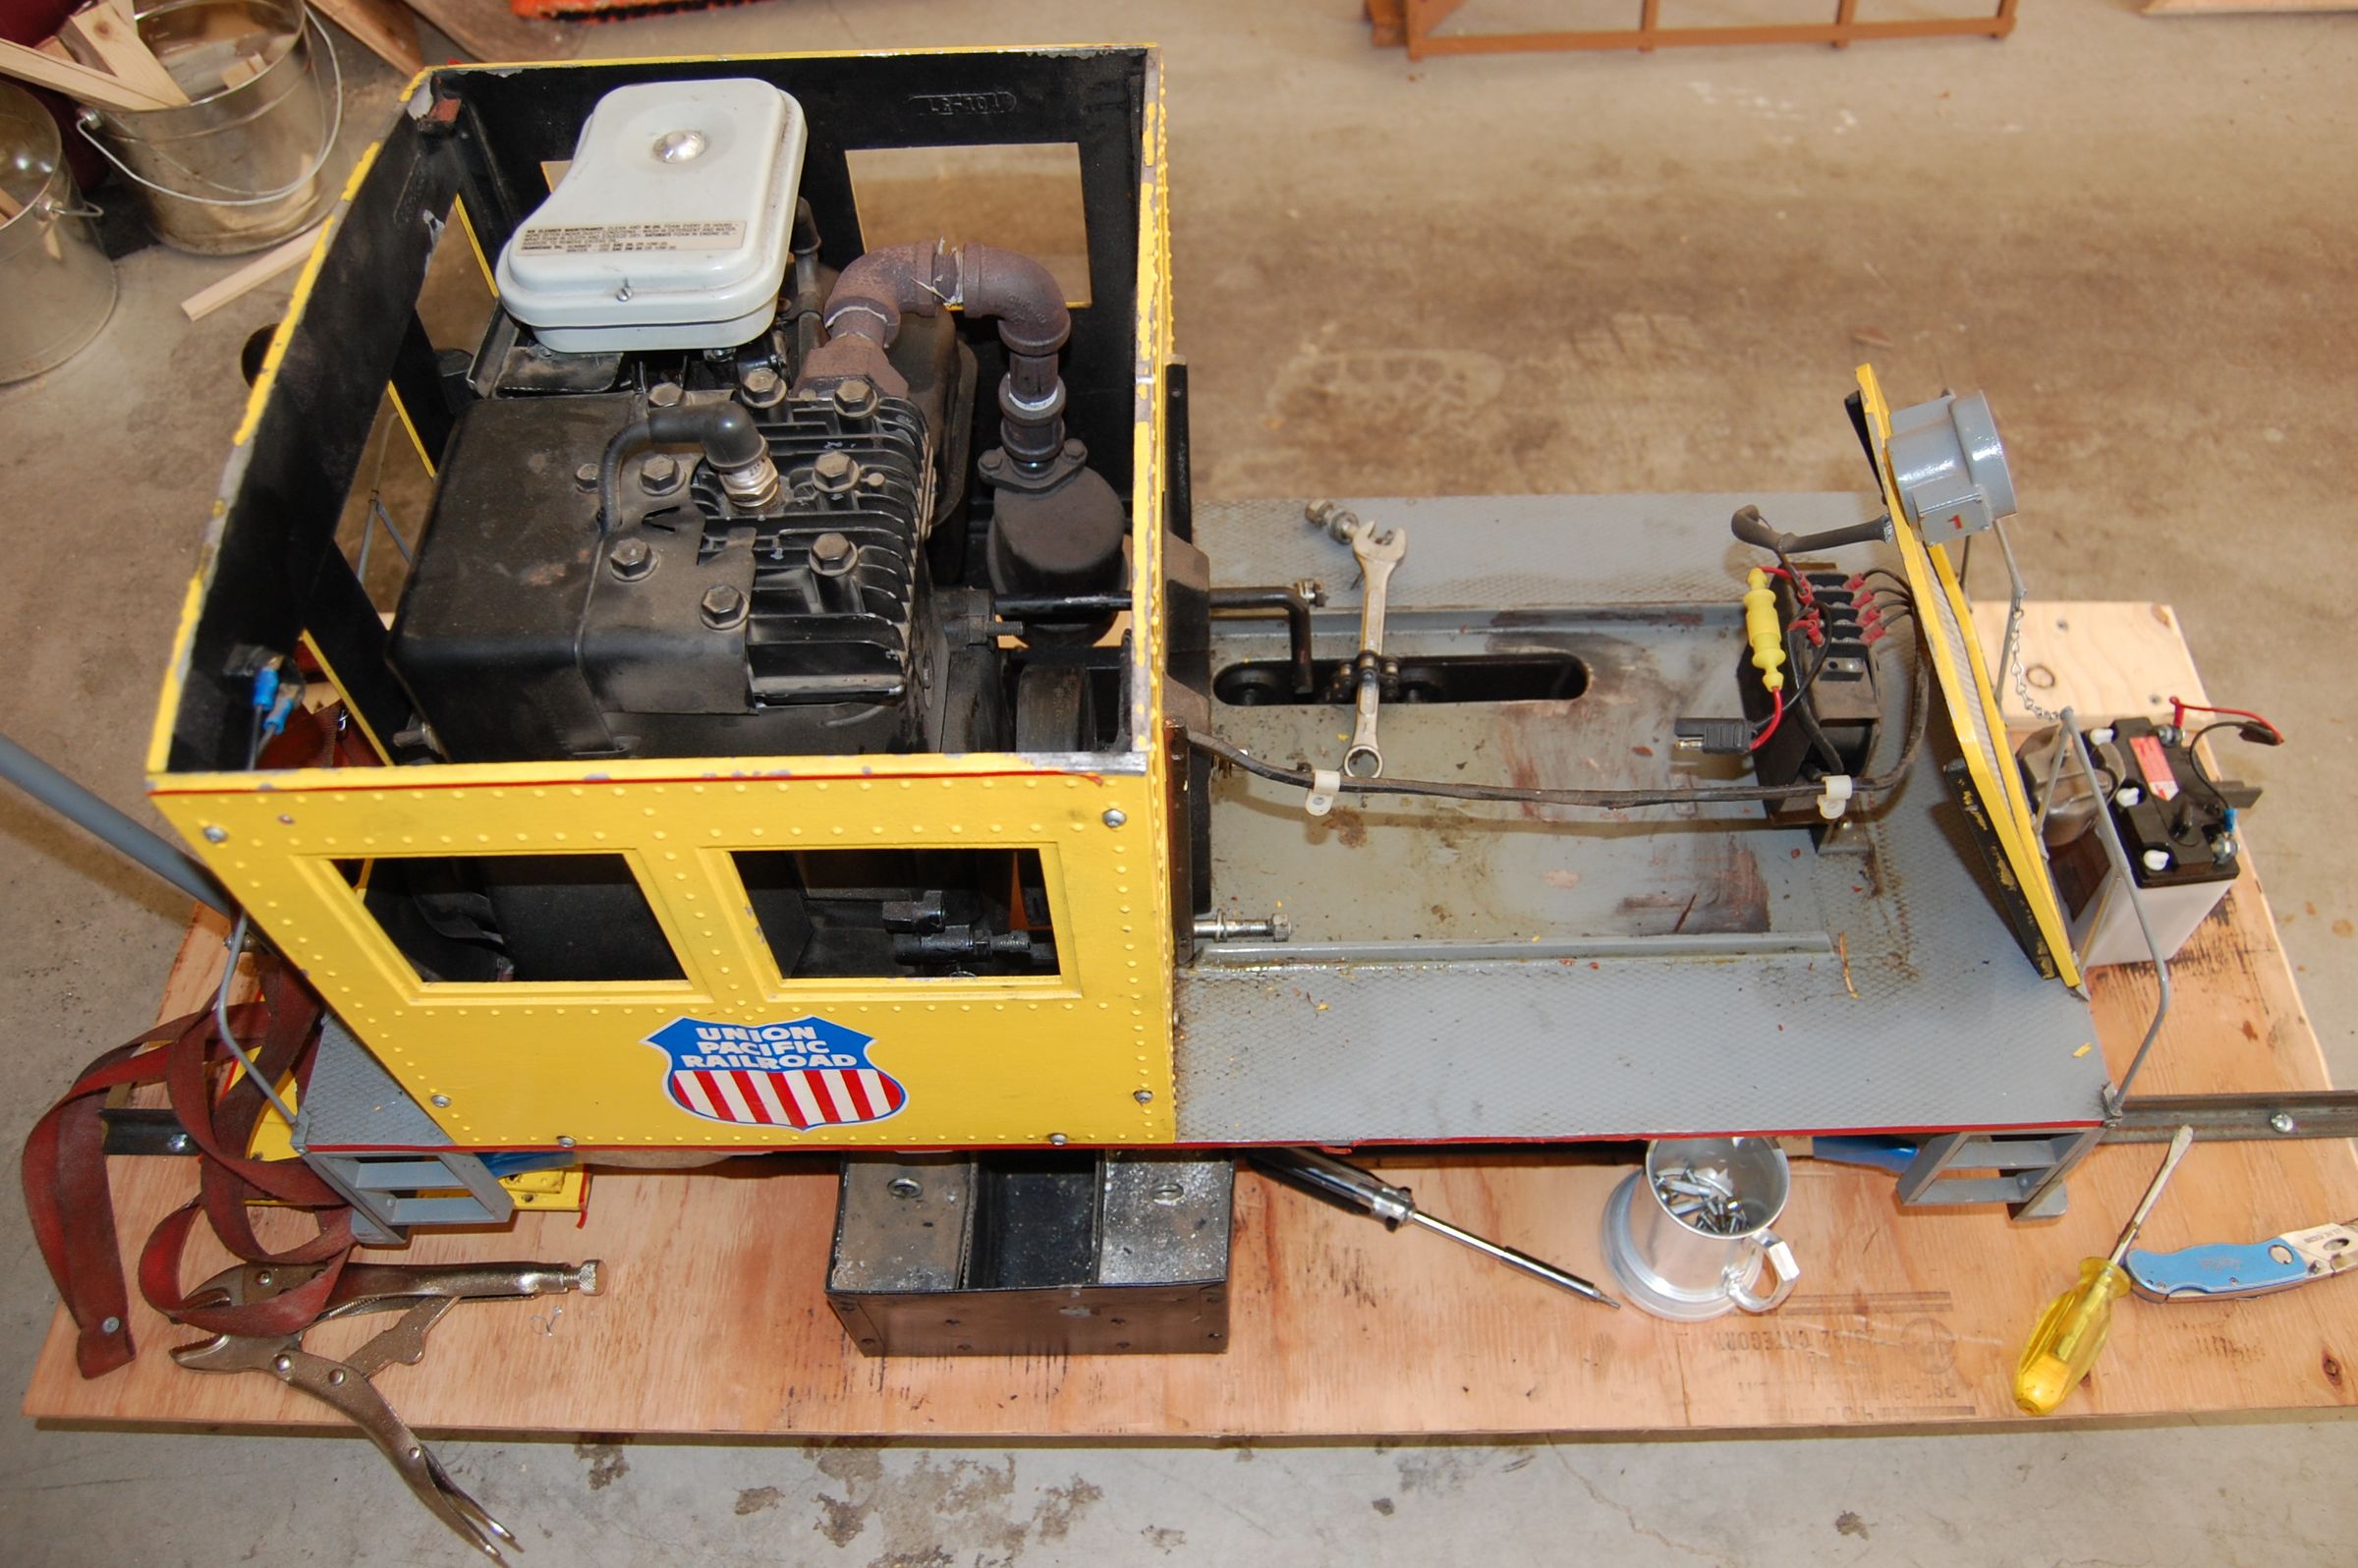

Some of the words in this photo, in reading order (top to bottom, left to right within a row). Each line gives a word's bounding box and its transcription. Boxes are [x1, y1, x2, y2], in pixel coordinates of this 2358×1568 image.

[696, 1026, 817, 1042] UNION
[697, 1040, 830, 1057] PACIFIC
[680, 1054, 858, 1070] RAILROAD
